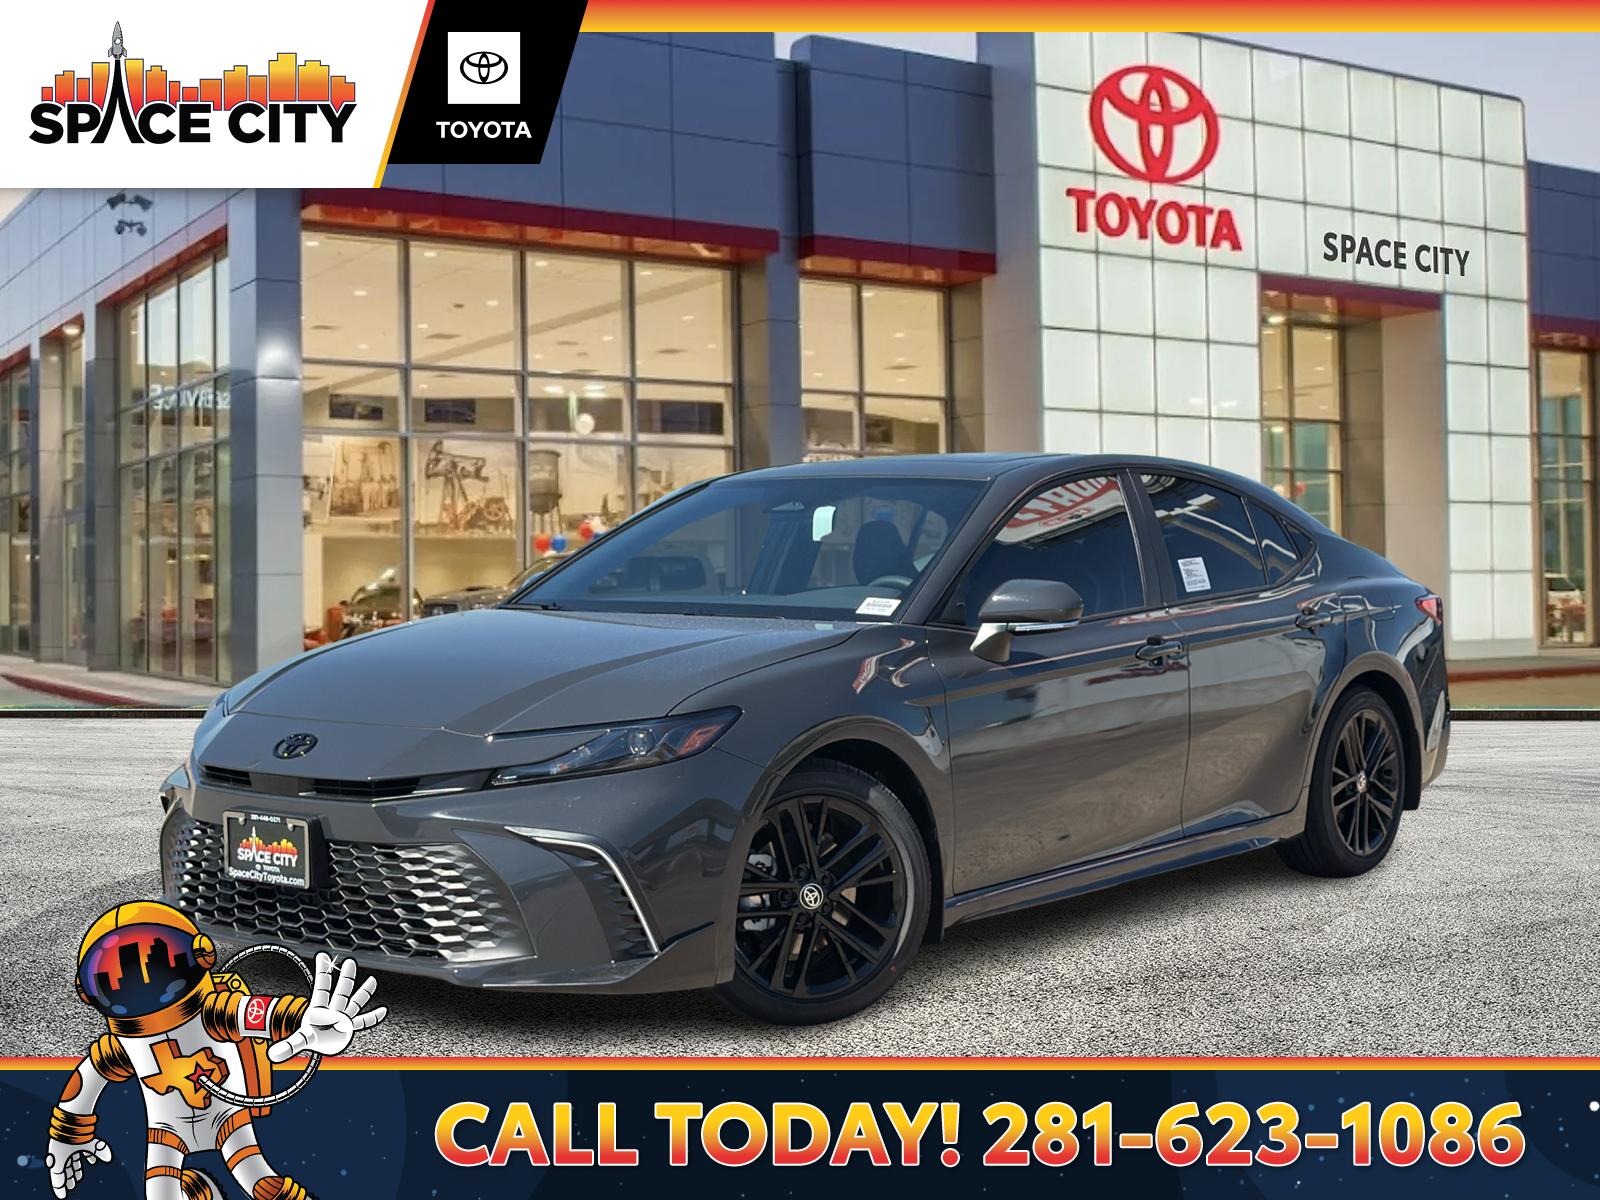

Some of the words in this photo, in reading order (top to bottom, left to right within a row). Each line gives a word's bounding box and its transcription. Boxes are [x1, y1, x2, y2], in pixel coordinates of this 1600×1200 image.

[1065, 187, 1242, 251] TOYOTA
[1323, 231, 1407, 270] SPACE
[1414, 244, 1470, 277] CITY
[228, 866, 305, 886] SpaceCityToyota.com
[272, 852, 298, 867] CITY
